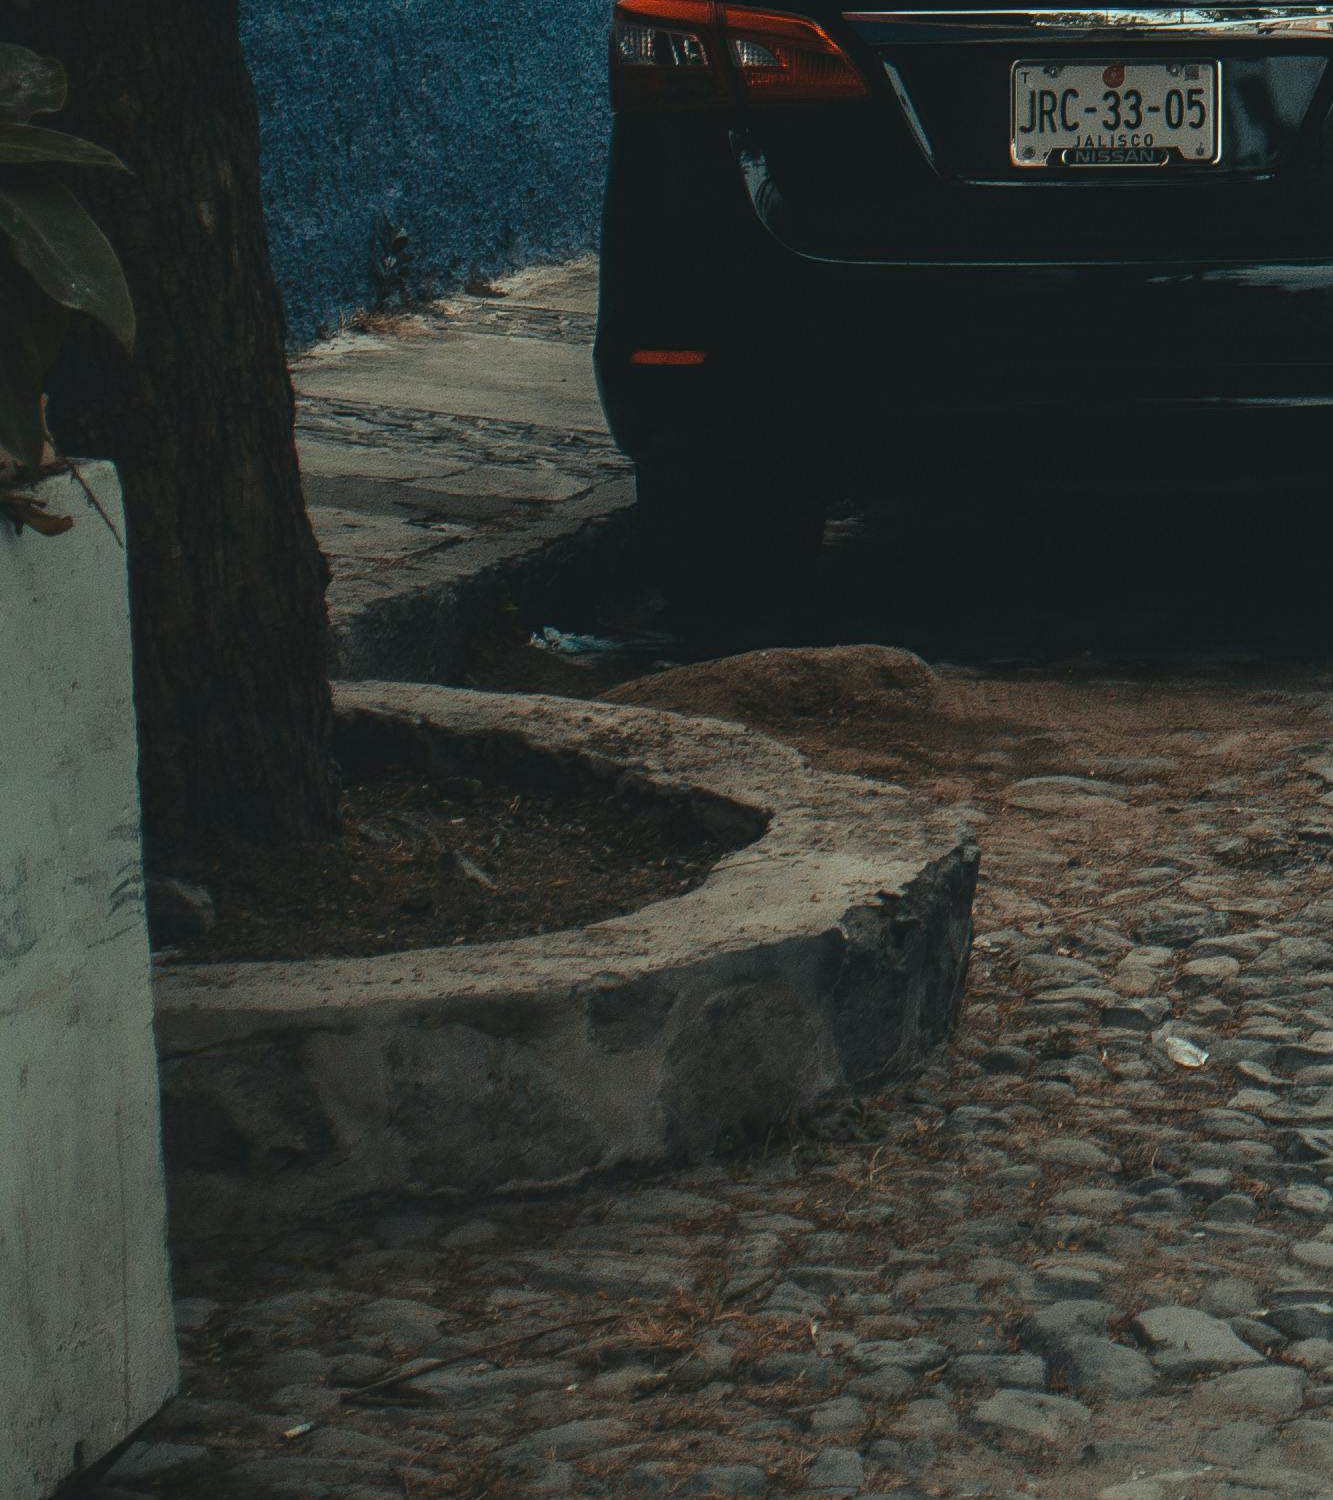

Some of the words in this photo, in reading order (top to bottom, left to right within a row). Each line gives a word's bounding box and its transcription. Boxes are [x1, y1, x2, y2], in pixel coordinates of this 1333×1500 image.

[1019, 88, 1206, 133] JRC-33-05
[1073, 133, 1154, 148] JALISCO
[1075, 149, 1154, 163] NISSAN
